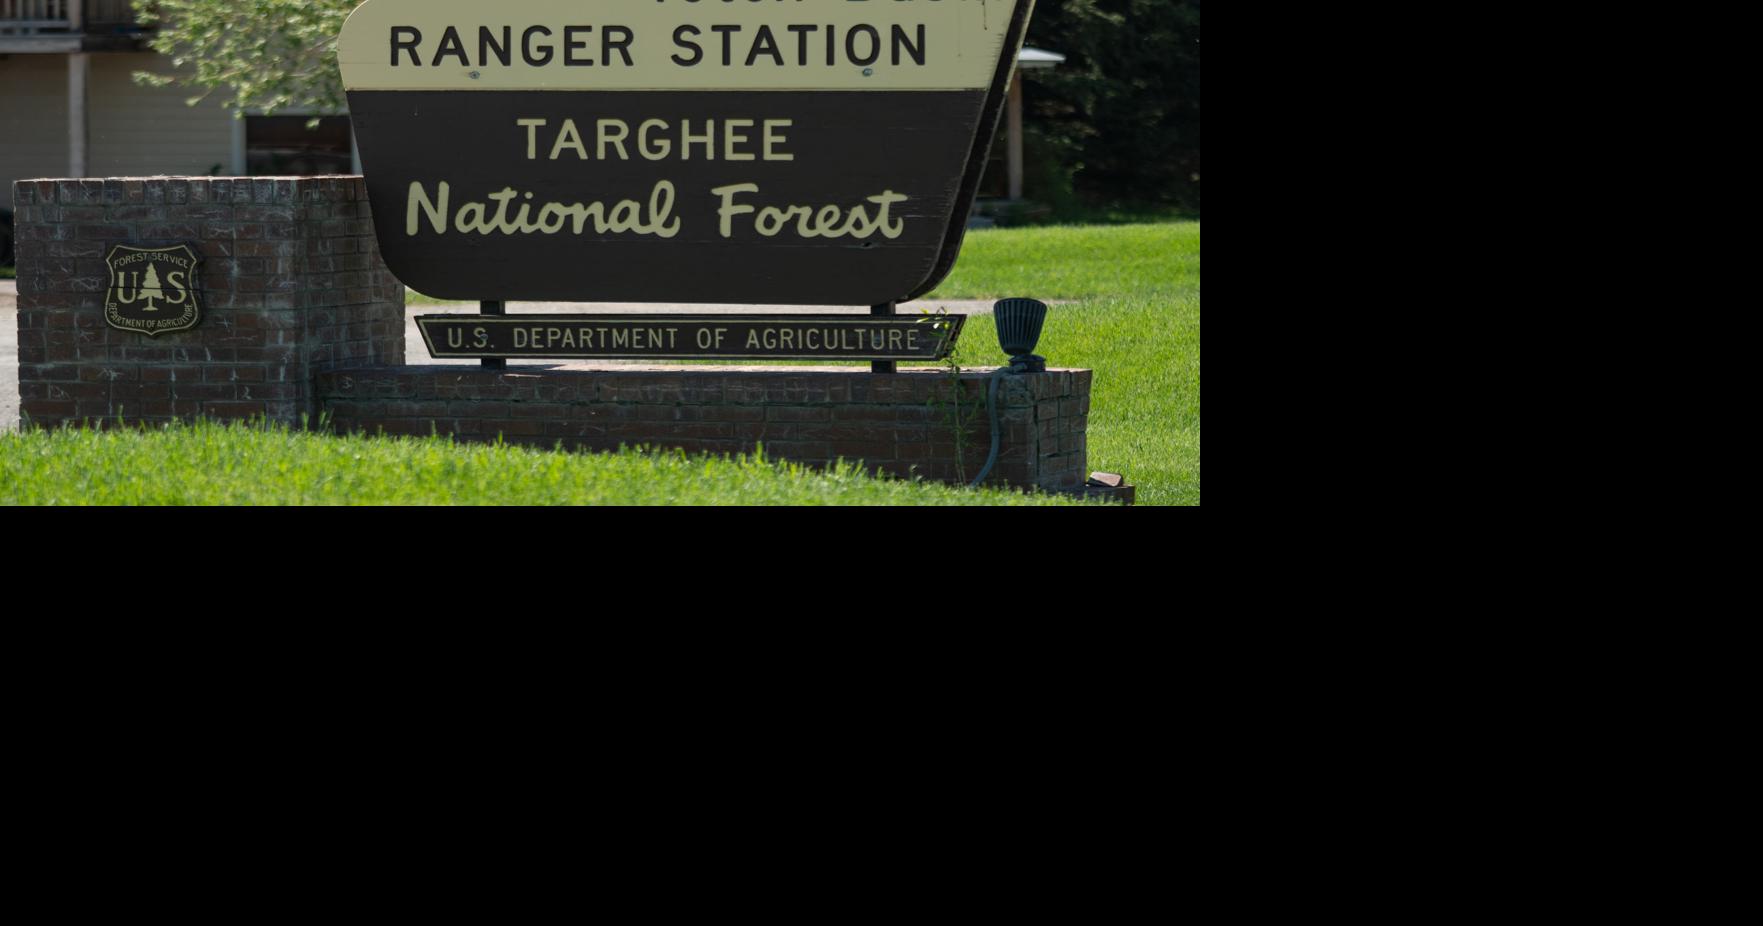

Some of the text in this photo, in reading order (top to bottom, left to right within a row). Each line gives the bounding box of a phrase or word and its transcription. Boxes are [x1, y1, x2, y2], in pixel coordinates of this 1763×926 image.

[389, 24, 927, 67] RANGER STATION
[516, 118, 794, 161] TARGHEE
[406, 180, 909, 239] National Forest
[114, 252, 188, 269] FOREST SERVICE
[146, 319, 156, 329] OF
[446, 327, 920, 351] U.S. DEPARTMENT OF AGRICULTURE
